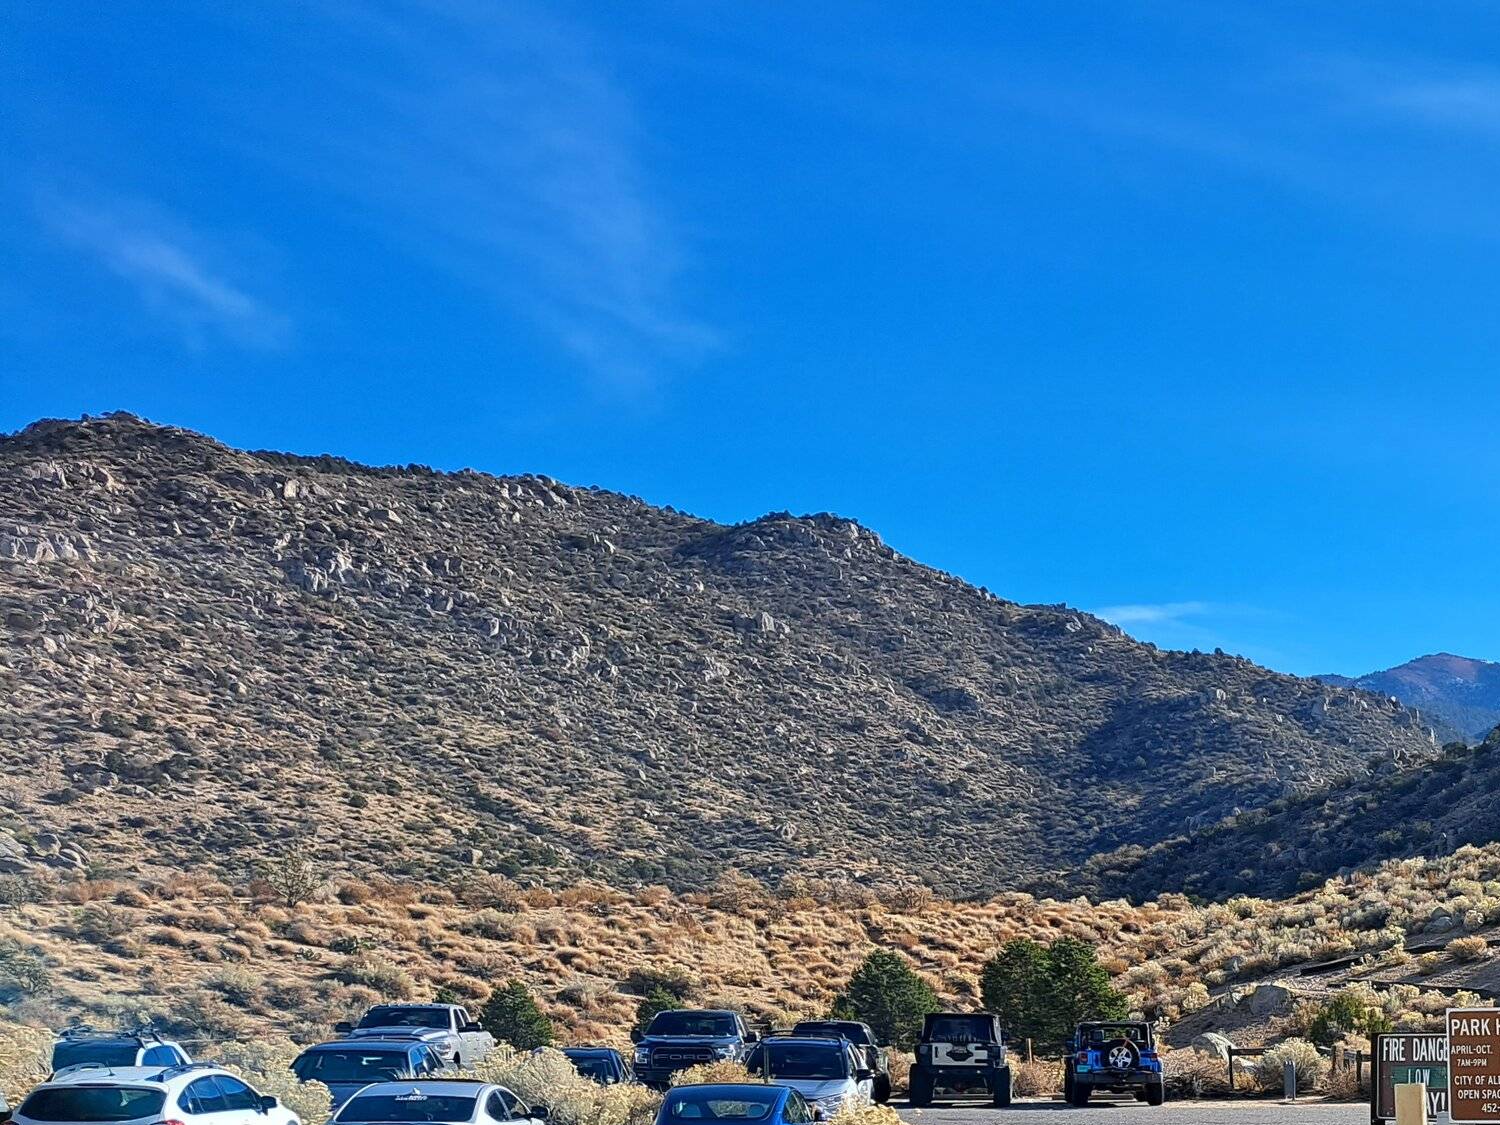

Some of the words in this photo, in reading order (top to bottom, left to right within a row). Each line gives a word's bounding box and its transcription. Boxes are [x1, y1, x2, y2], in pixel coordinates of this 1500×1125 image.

[1451, 1018, 1491, 1036] PARK
[1383, 1038, 1405, 1061] FIRE
[1412, 1038, 1448, 1061] DANGE
[1457, 1059, 1487, 1067] 7AM-9PM
[1454, 1075, 1472, 1085] CITY
[1475, 1075, 1485, 1085] OF
[1458, 1089, 1479, 1099] OPEN
